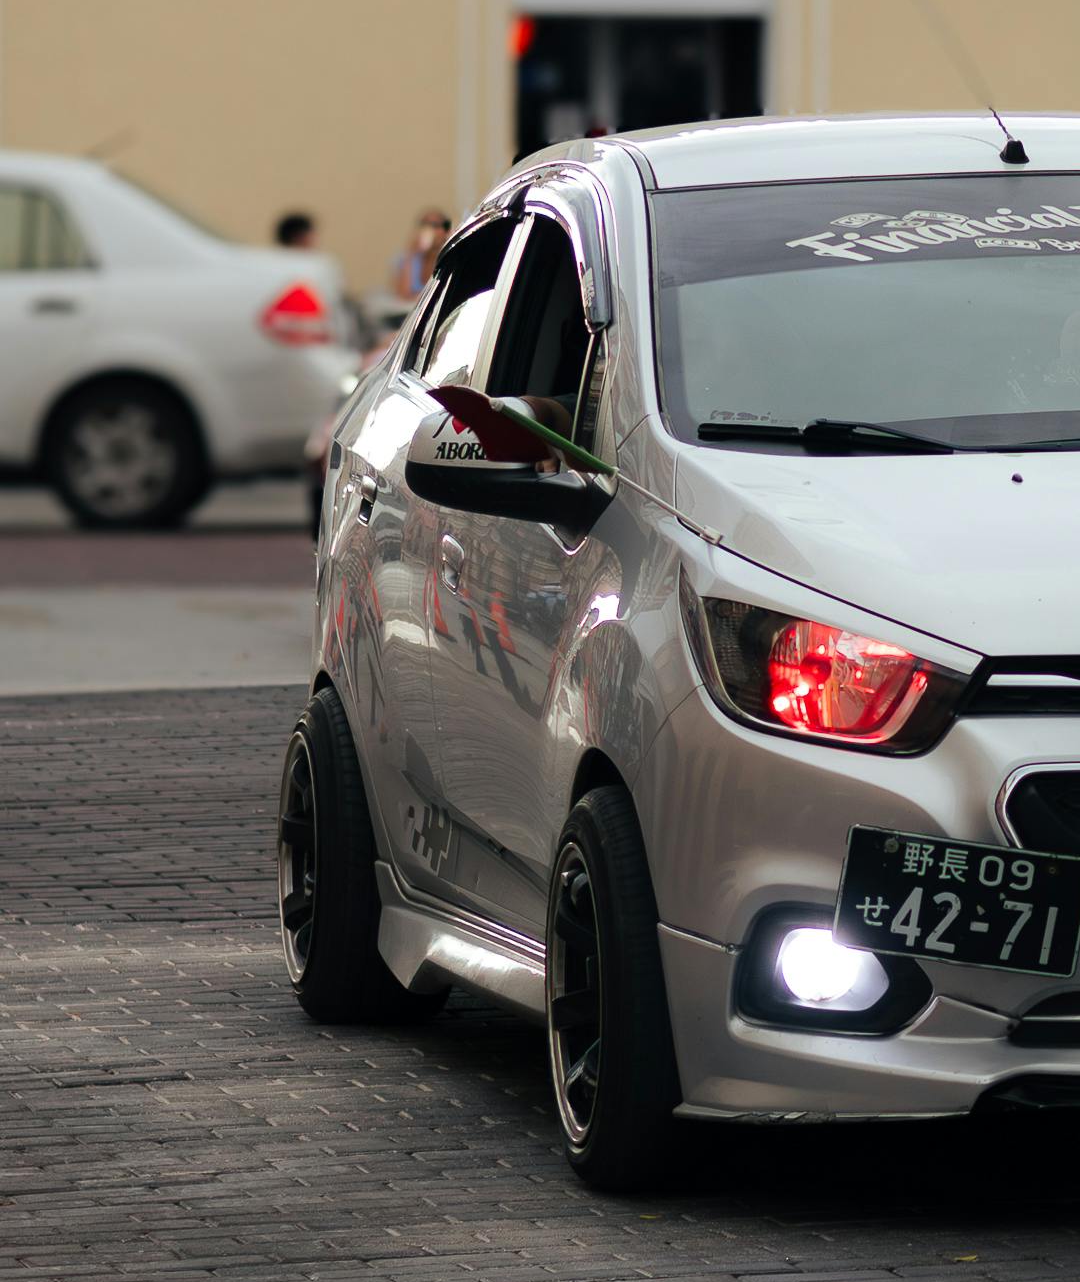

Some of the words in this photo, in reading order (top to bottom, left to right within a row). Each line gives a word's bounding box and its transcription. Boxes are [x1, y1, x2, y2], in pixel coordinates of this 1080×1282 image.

[978, 855, 1035, 891] 09
[856, 896, 890, 926] せ
[890, 886, 1058, 965] 42-71
